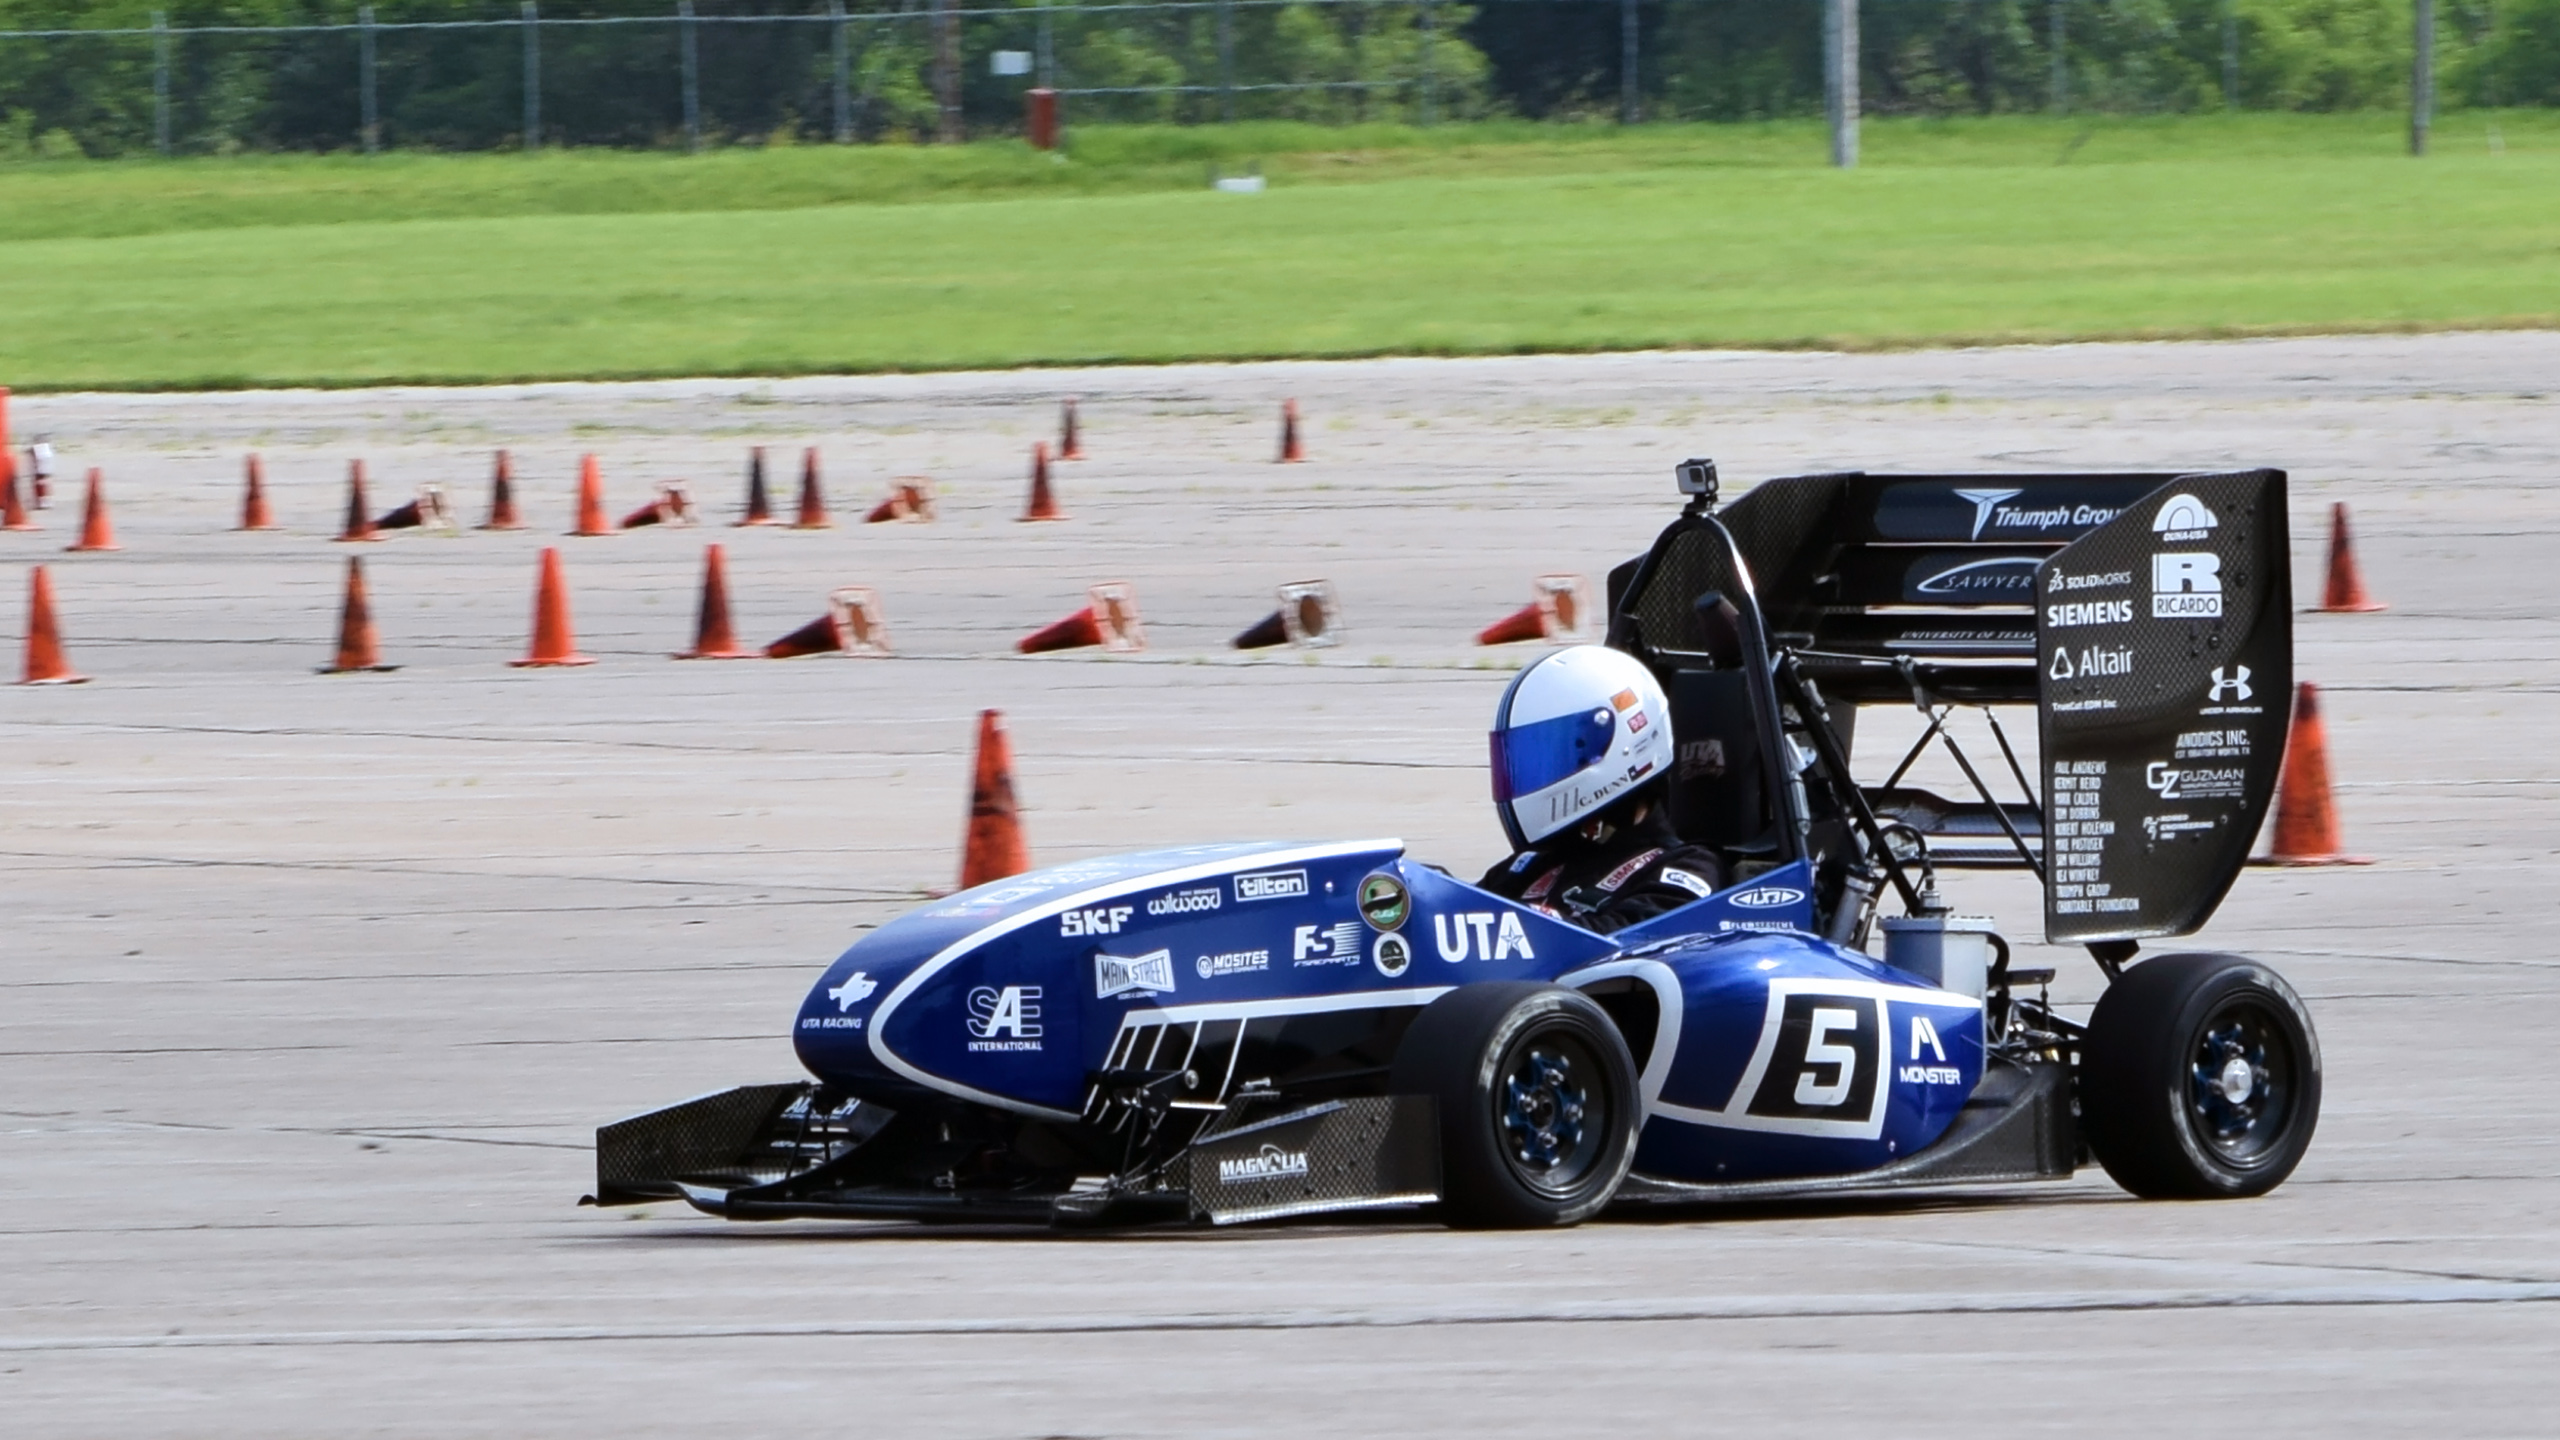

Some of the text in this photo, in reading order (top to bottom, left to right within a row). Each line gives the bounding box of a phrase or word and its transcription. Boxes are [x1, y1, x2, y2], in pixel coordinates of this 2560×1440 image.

[1996, 505, 2124, 531] Triumph Grou
[1945, 575, 2032, 589] SAWYER
[2048, 600, 2133, 627] SIEMENS
[2156, 598, 2219, 614] RICARDO
[1901, 631, 1973, 639] UNIVERSITY
[1976, 631, 1994, 639] OF
[2079, 645, 2133, 677] Altair
[2176, 730, 2250, 748] ANODICS INC.
[1594, 774, 1629, 800] DUNN
[2181, 769, 2244, 781] GUZMAN
[1240, 877, 1303, 896] tilton
[1147, 887, 1221, 915] wilwood
[1061, 906, 1133, 937] SKF
[1434, 912, 1535, 963] UTA
[1214, 950, 1269, 967] MOSITES
[1101, 957, 1168, 991] MAIN STREET
[802, 1018, 862, 1029] UTA RACING
[967, 986, 1043, 1038] SAE
[968, 1041, 1043, 1052] INTERNATIONAL
[1794, 1008, 1857, 1106] 5
[1900, 1066, 1961, 1085] MONSTER
[1220, 1153, 1307, 1177] MAGNOLIA
